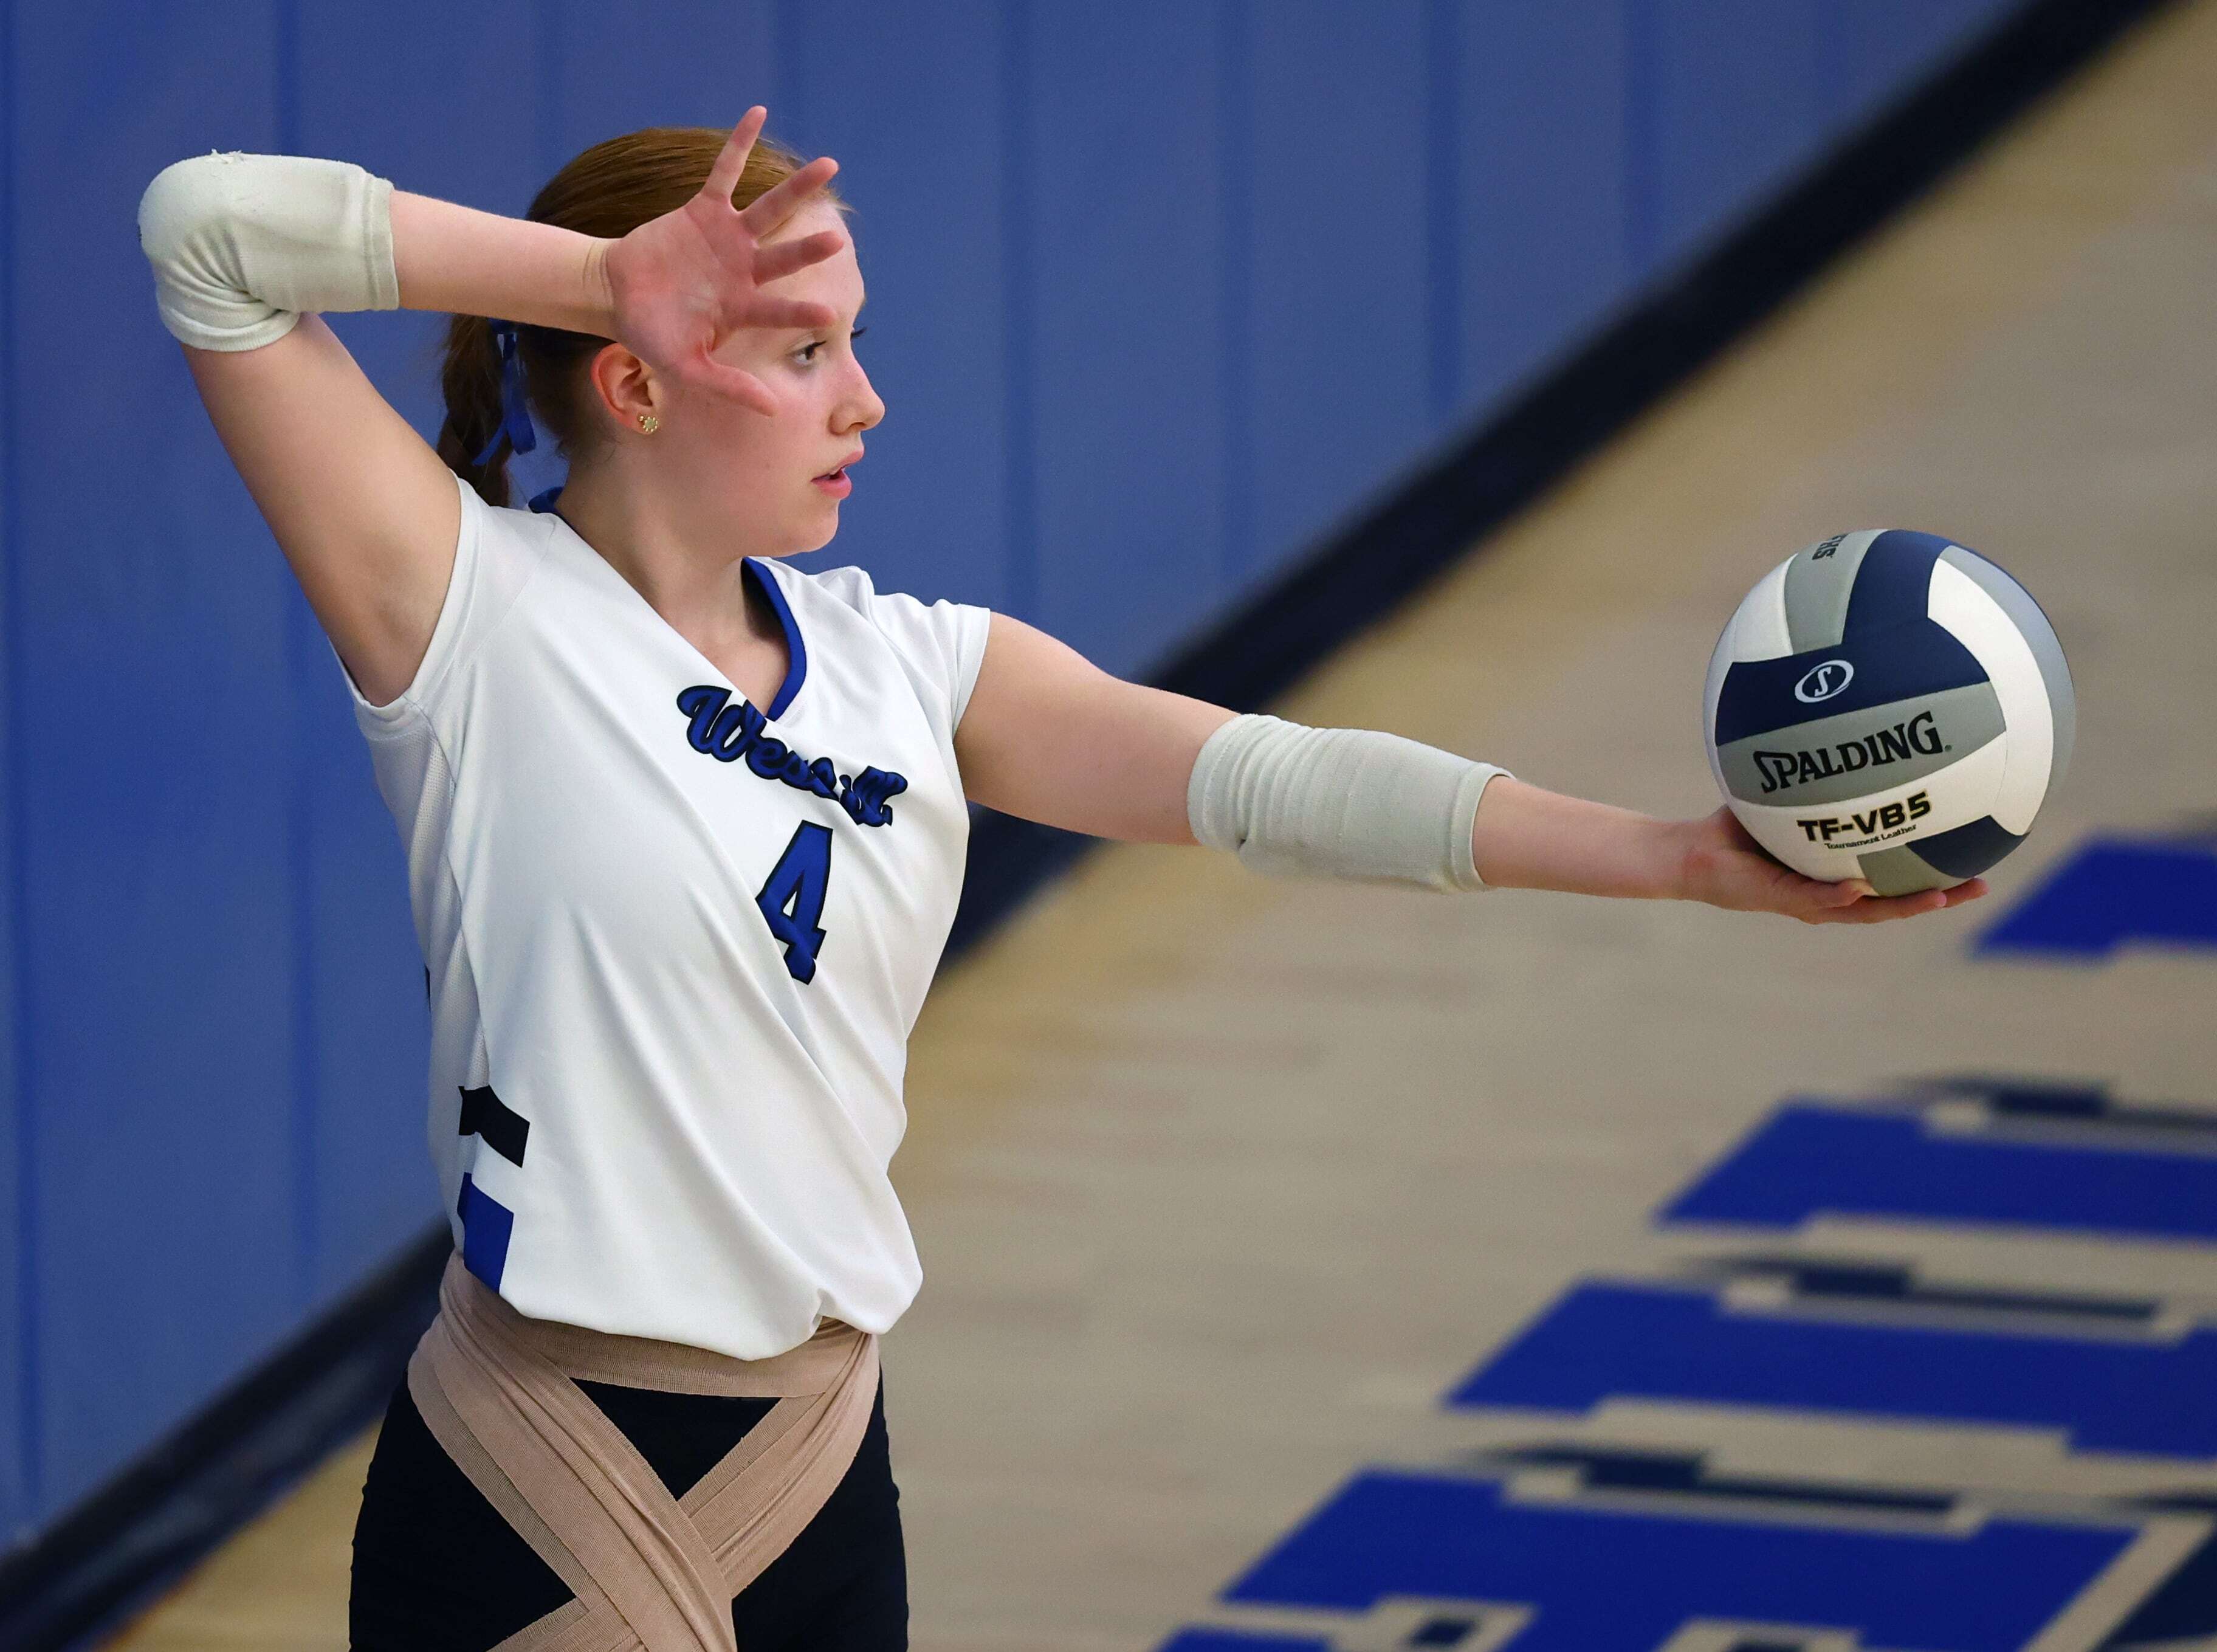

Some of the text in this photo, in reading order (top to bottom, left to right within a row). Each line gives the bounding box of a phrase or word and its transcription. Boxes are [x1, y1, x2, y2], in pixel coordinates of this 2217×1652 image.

[1753, 711, 1944, 793] SPALDING
[1796, 791, 1931, 841] TF-VB5
[1824, 824, 1917, 850] Tournament Leather
[755, 819, 834, 986] 4
